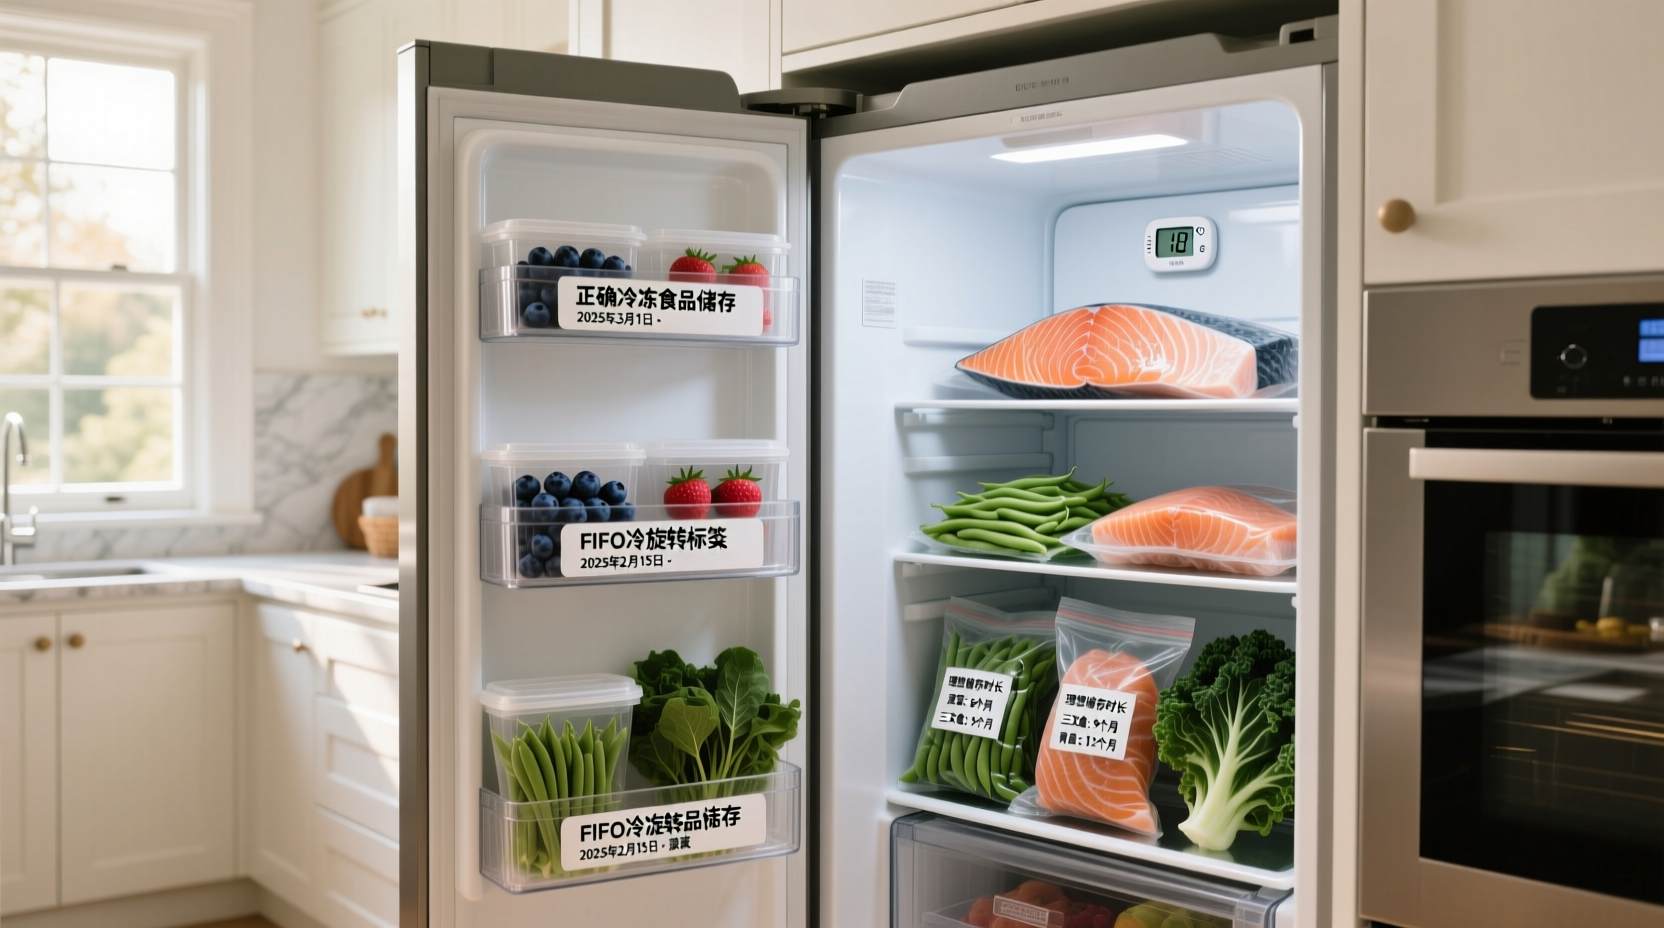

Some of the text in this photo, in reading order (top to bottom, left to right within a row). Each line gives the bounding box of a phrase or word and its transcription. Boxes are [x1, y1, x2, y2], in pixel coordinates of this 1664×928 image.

[1171, 232, 1188, 253] 18
[575, 285, 737, 314] 正确冷冻食品储存
